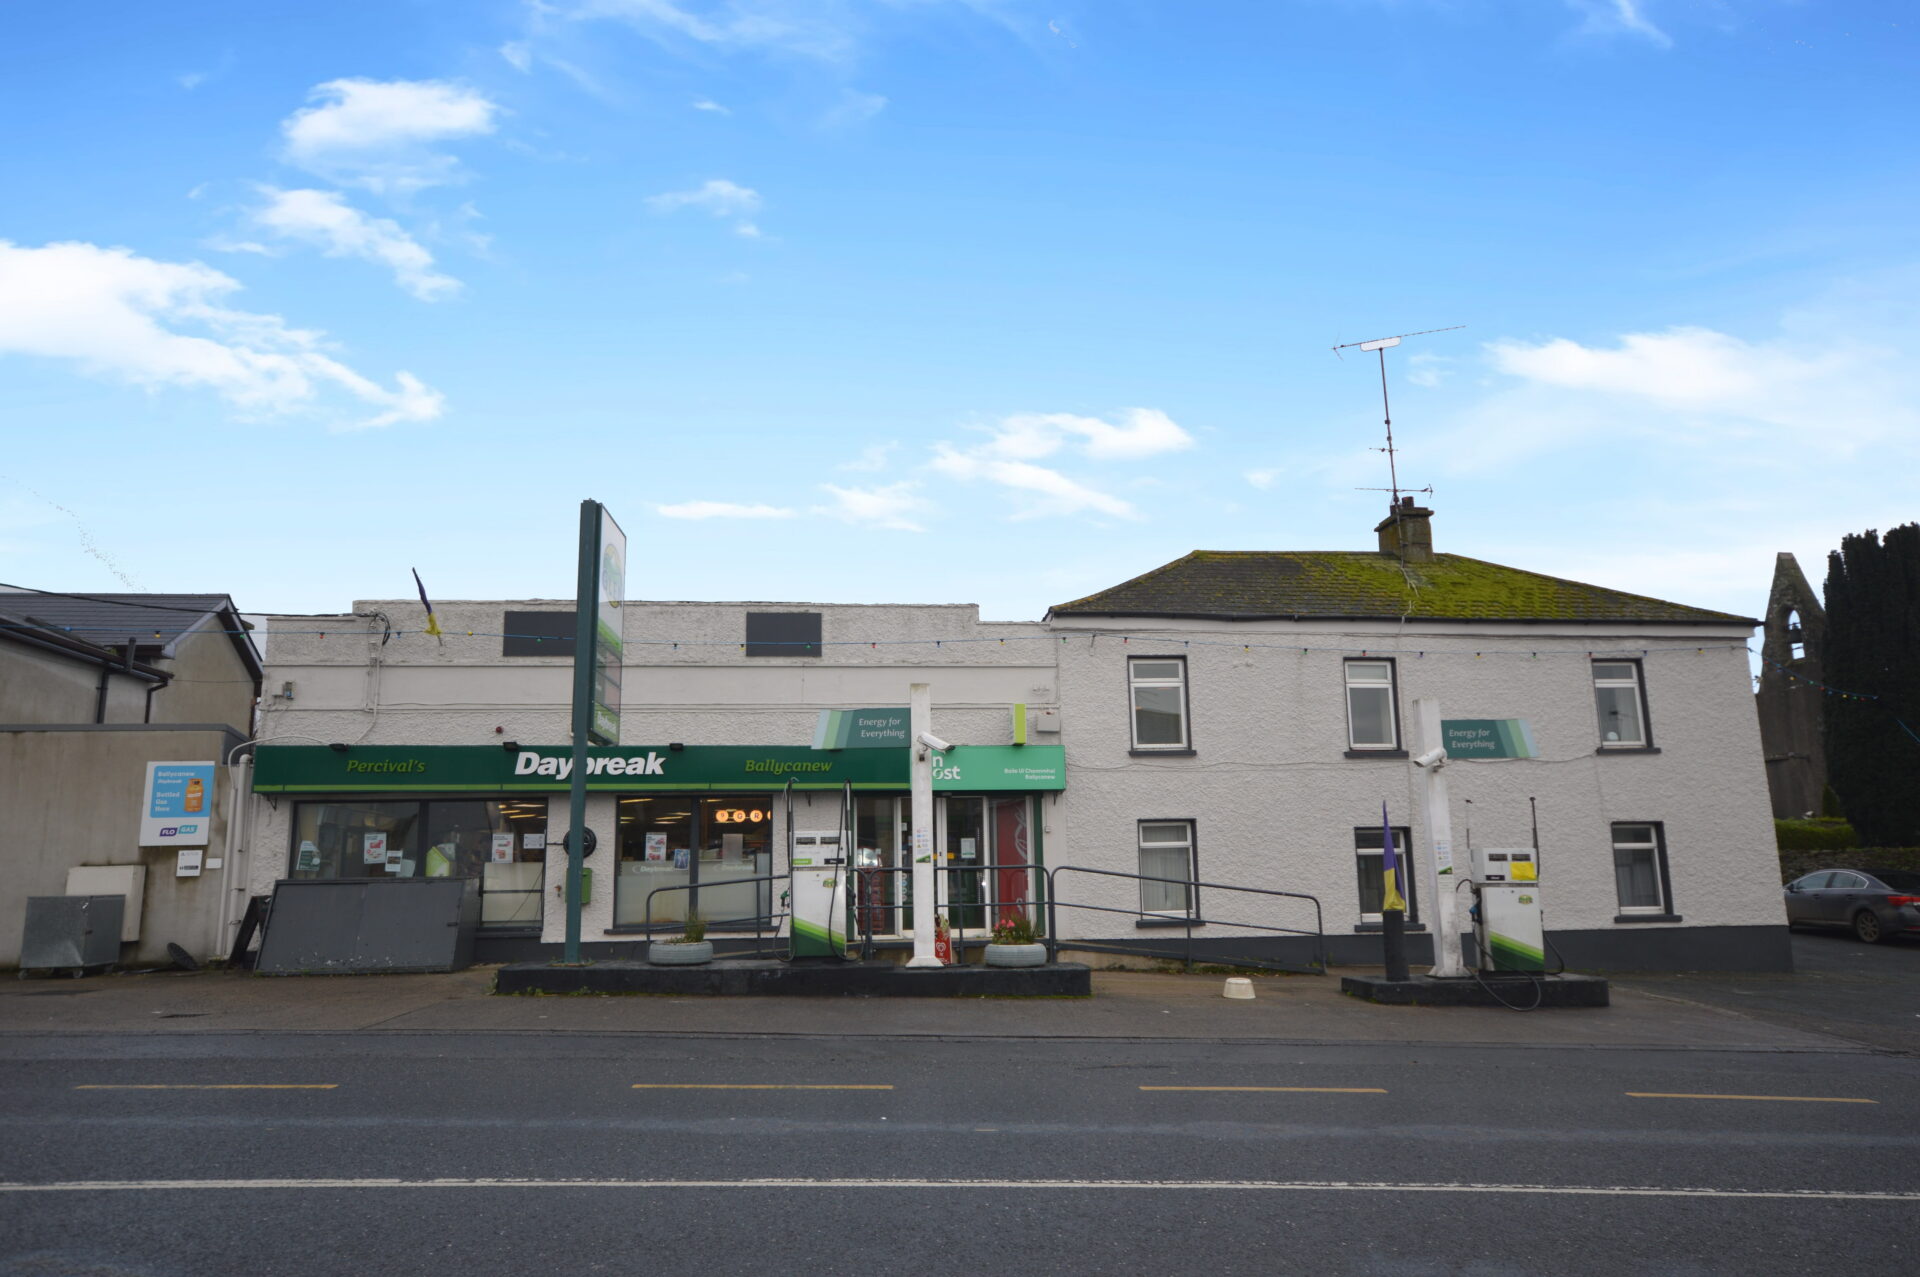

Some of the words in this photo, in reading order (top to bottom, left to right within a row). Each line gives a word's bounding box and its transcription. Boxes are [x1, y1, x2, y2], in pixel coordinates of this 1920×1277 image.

[858, 718, 887, 726] Energy
[888, 717, 901, 725] for
[861, 730, 904, 738] Everything
[1449, 730, 1476, 738] Energy
[1478, 729, 1490, 737] for
[1452, 741, 1495, 749] Everything
[347, 759, 425, 773] Percival's
[745, 759, 833, 774] Ballycanew
[932, 766, 961, 780] ost
